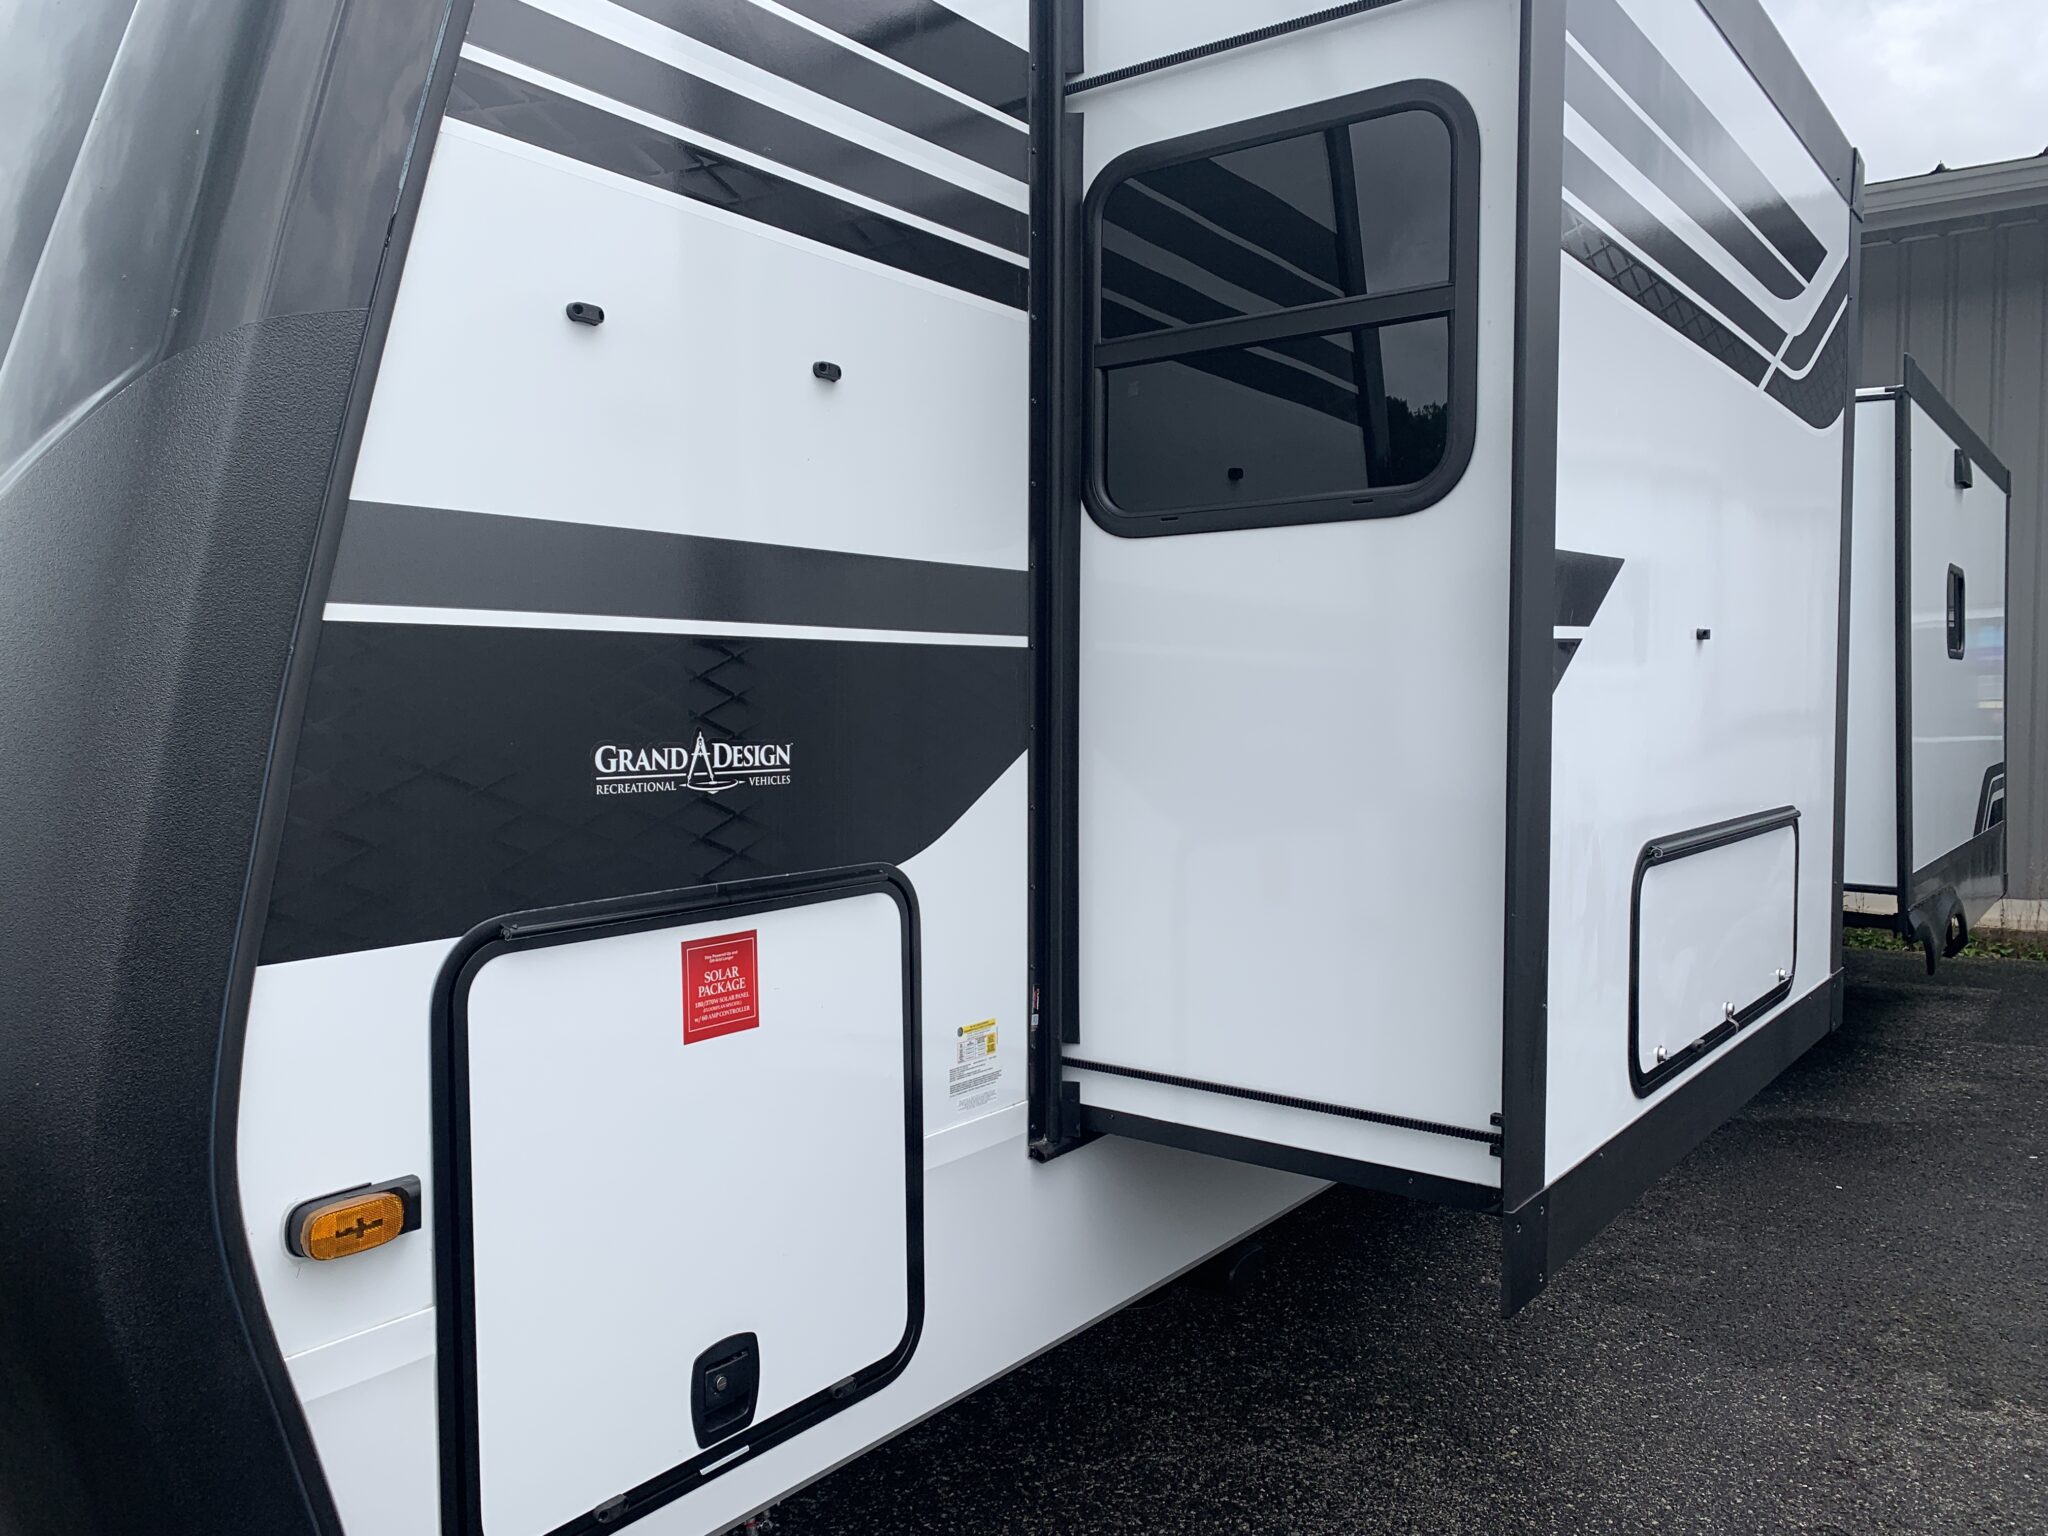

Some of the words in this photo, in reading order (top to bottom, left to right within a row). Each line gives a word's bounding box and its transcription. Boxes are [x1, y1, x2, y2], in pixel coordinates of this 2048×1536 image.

[594, 745, 688, 773] GRAND
[712, 742, 791, 769] DESIGN
[596, 781, 677, 795] RECREATIONAL
[749, 775, 791, 786] VEHICLES
[704, 966, 739, 983] SOLAR
[698, 977, 746, 998] PACKAGE
[719, 995, 735, 1003] SOLAR
[735, 992, 749, 1000] PANEL
[709, 1010, 720, 1019] AMP
[720, 1005, 750, 1017] CONTROLLER
